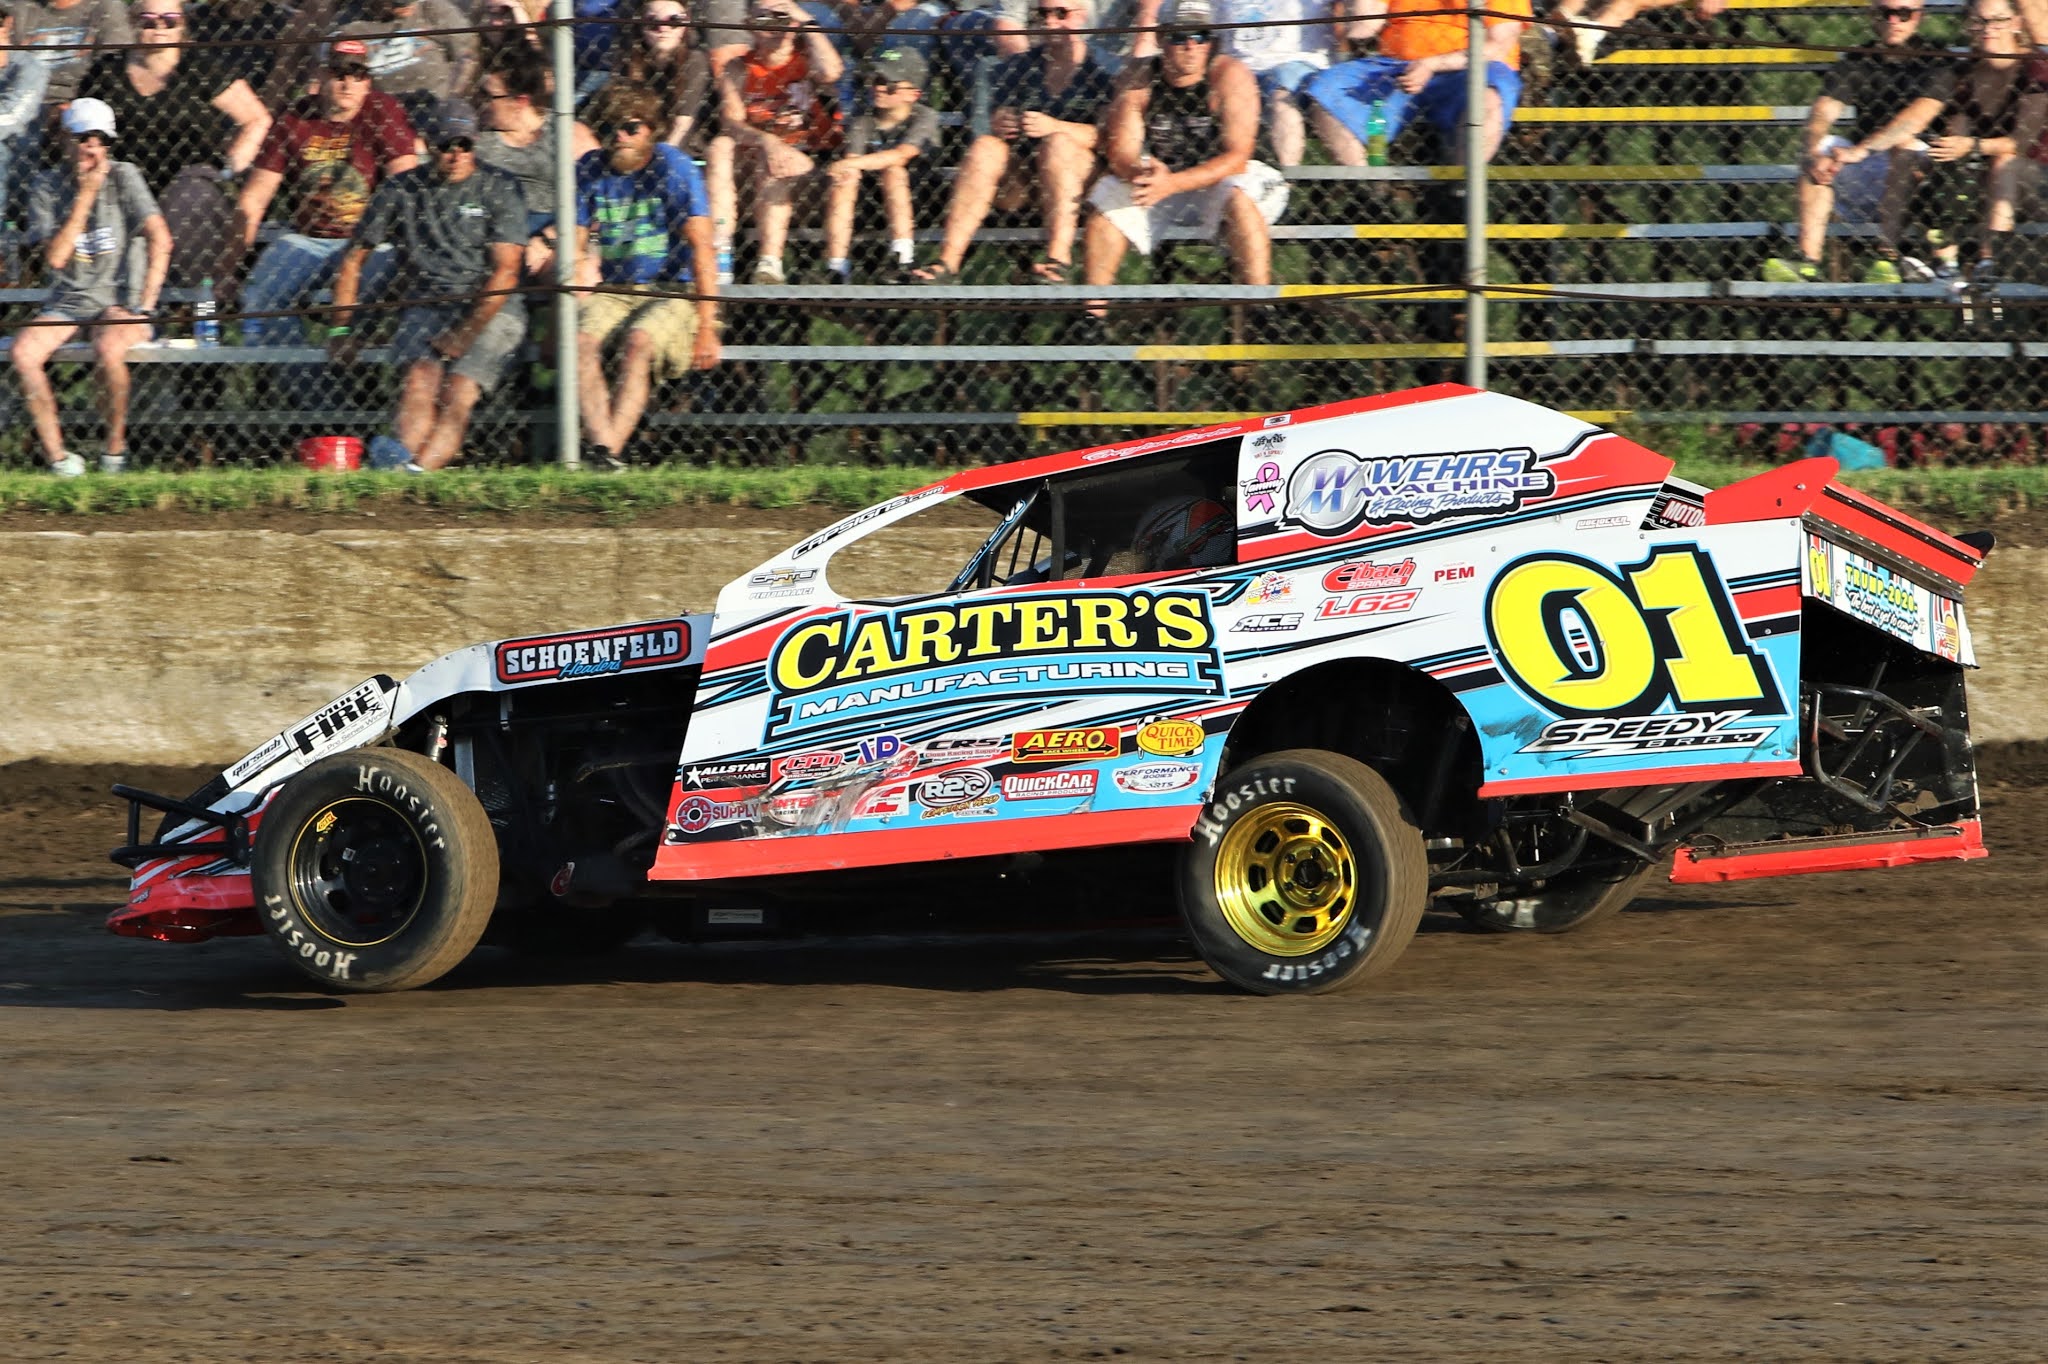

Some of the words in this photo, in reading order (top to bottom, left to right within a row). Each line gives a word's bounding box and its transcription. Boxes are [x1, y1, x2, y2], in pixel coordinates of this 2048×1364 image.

[1372, 453, 1530, 484] WEHRS
[1240, 477, 1285, 496] Tammy
[1355, 476, 1546, 497] MACHINE
[1385, 495, 1436, 514] Racing
[1436, 492, 1511, 509] Products
[1322, 558, 1416, 592] Eibach
[1433, 566, 1475, 582] PEM
[1809, 546, 1832, 597] 01
[1347, 577, 1402, 590] SPRINGS
[750, 587, 814, 600] PERFORMANCE
[1242, 613, 1303, 627] ACE
[1491, 551, 1765, 711] 01
[506, 630, 679, 674] SCHOENFELD
[777, 595, 1209, 691] CARTER'S
[559, 657, 622, 678] Headers
[798, 662, 1189, 719] MANUFACTURING
[314, 685, 370, 723] MULTI
[293, 689, 377, 756] FIRE
[1145, 725, 1195, 739] QUICK
[1540, 711, 1722, 747] SPEEDY
[326, 738, 341, 751] Pro
[926, 737, 1003, 750] CRS
[1023, 730, 1105, 749] AERO
[1157, 736, 1196, 750] TIME
[1646, 732, 1753, 749] BRAY
[700, 762, 769, 776] ALLSTAR
[785, 754, 842, 770] CPD
[1115, 764, 1200, 778] PERFORMANCE
[924, 776, 985, 799] R2C
[1046, 788, 1090, 796] PRODUCTS
[712, 804, 759, 820] SUPPLY
[1194, 772, 1297, 848] Hoosier
